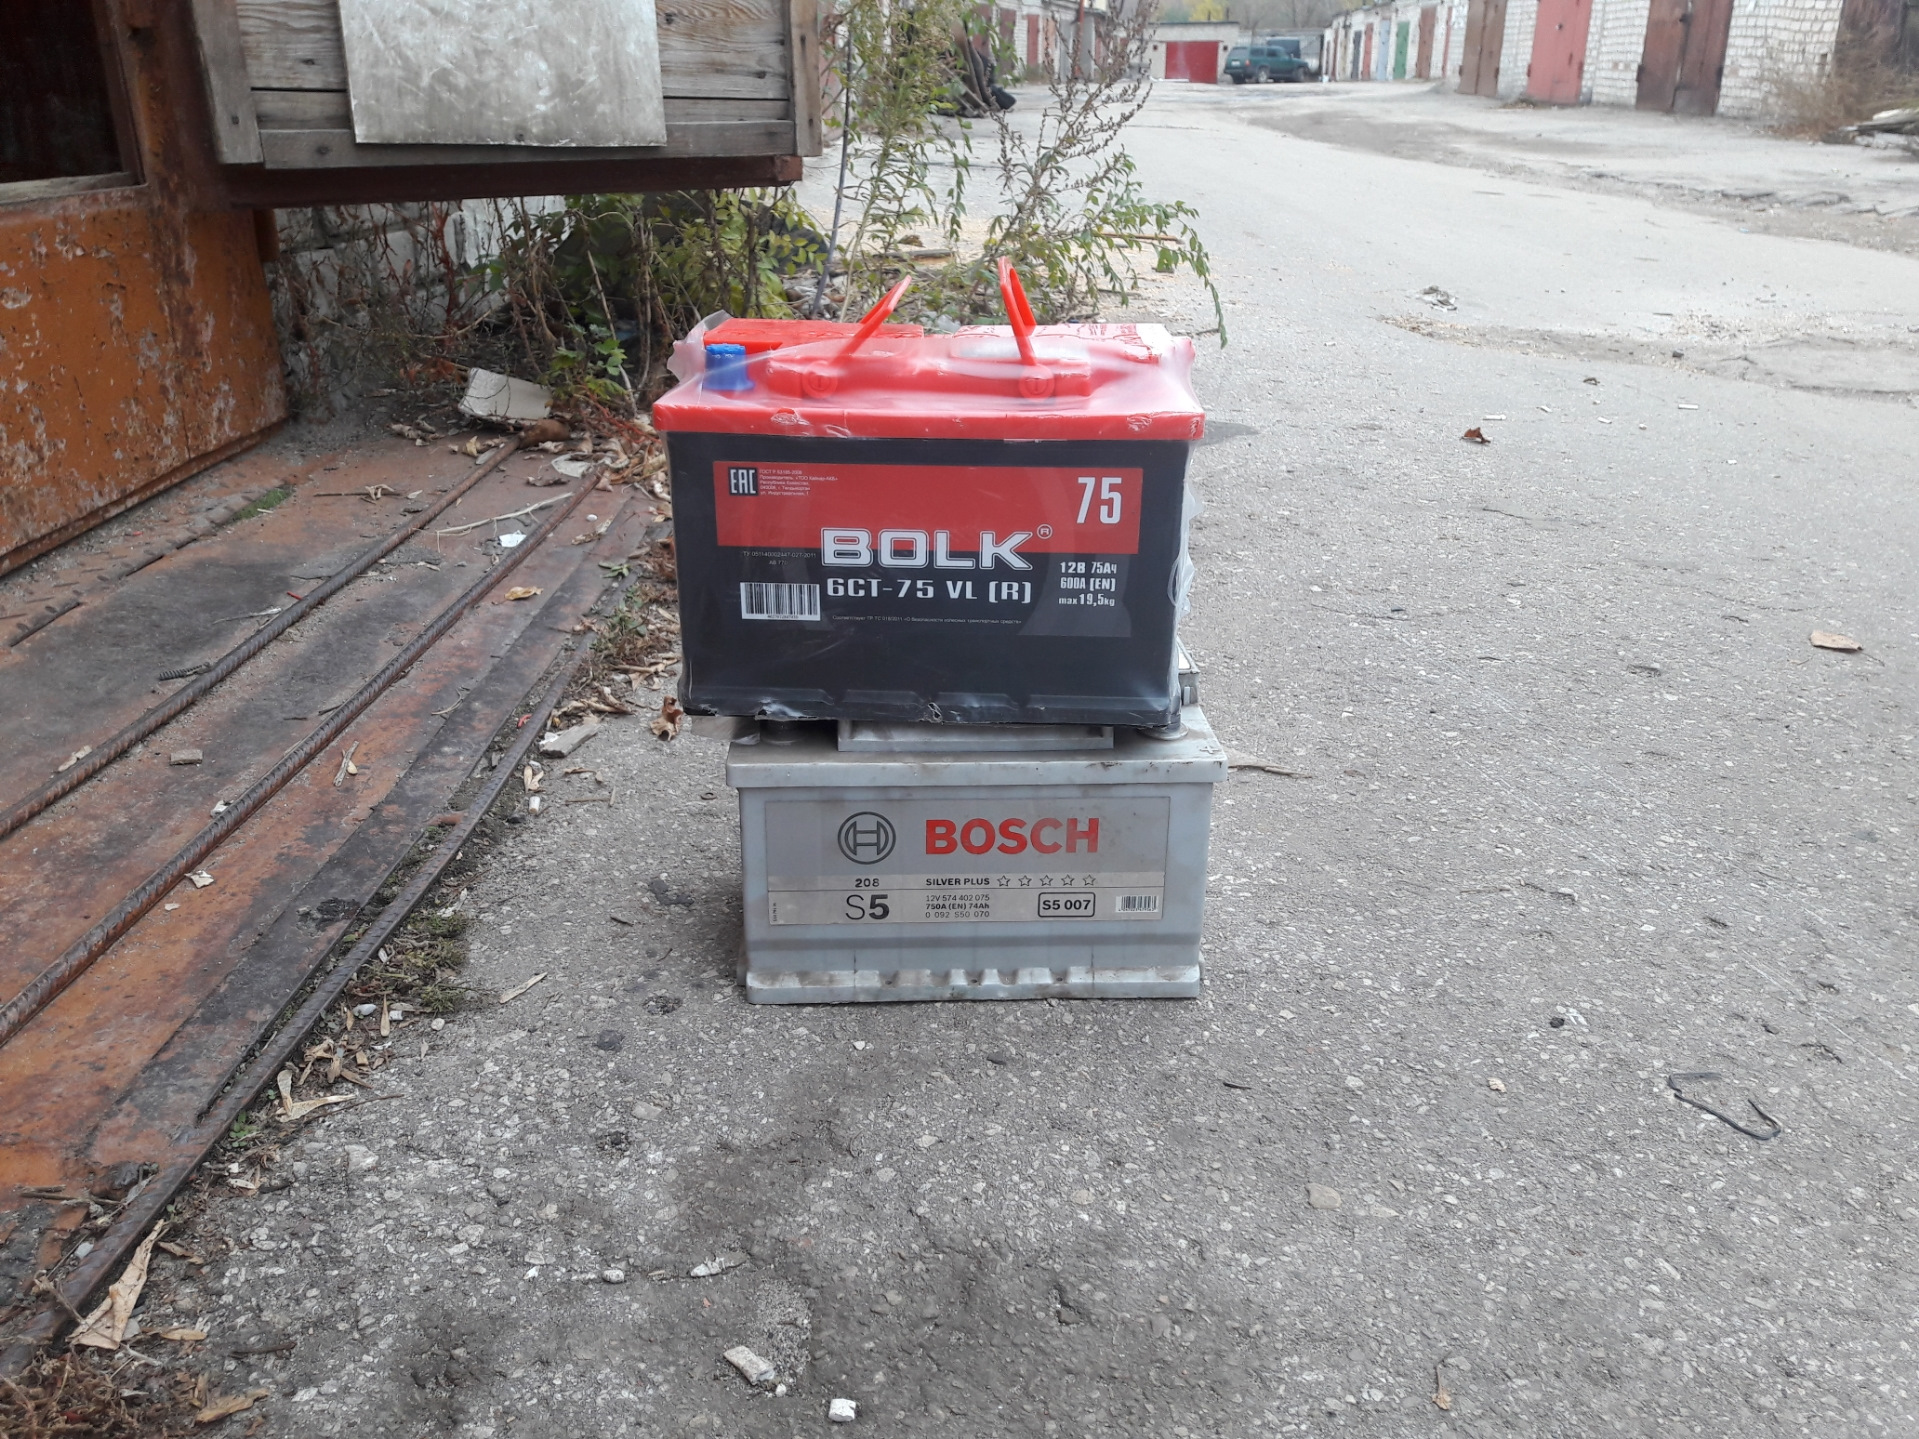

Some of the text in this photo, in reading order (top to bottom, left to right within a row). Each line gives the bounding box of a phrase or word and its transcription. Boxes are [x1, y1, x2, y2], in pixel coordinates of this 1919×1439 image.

[730, 469, 757, 494] EAC
[1076, 476, 1122, 524] 75
[820, 527, 1033, 571] BOLK
[946, 580, 977, 600] VL
[1058, 597, 1078, 605] max
[925, 818, 1100, 855] BOSCH
[855, 878, 880, 888] 208
[926, 877, 990, 886] SILVER PLUS
[845, 894, 890, 920] S5
[948, 903, 966, 911] (EN)
[1042, 899, 1091, 910] S5 007
